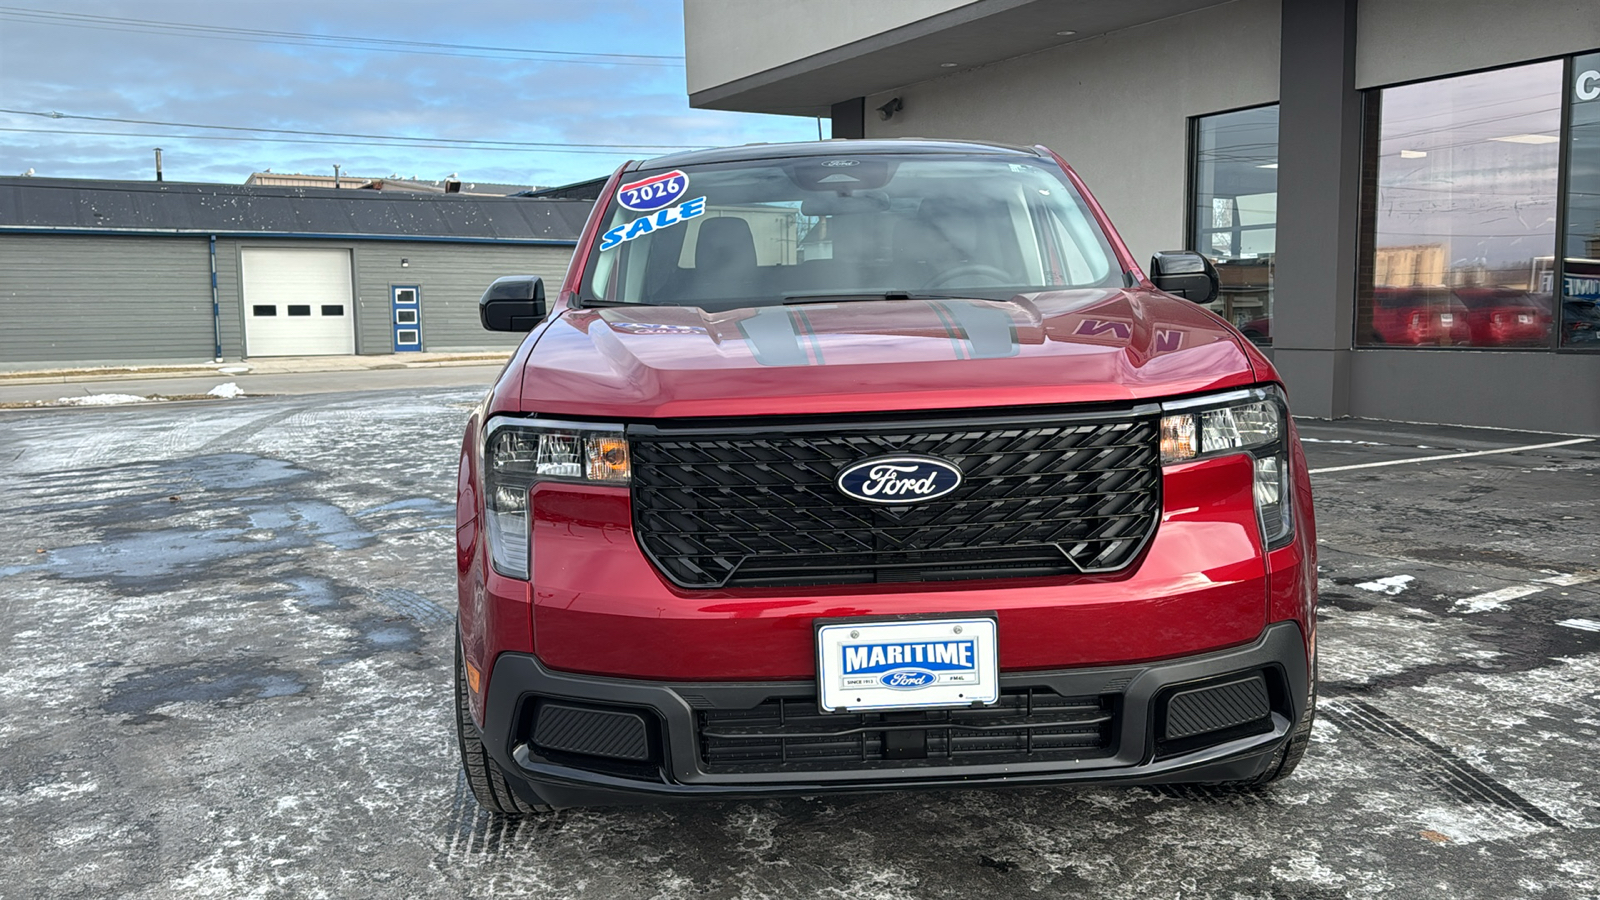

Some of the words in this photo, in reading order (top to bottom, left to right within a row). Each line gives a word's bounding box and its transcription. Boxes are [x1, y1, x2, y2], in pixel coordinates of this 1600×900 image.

[627, 178, 680, 206] 2026
[600, 196, 706, 251] SALE
[862, 465, 938, 495] Ford
[844, 642, 973, 672] MARITIME
[890, 672, 926, 686] Ford
